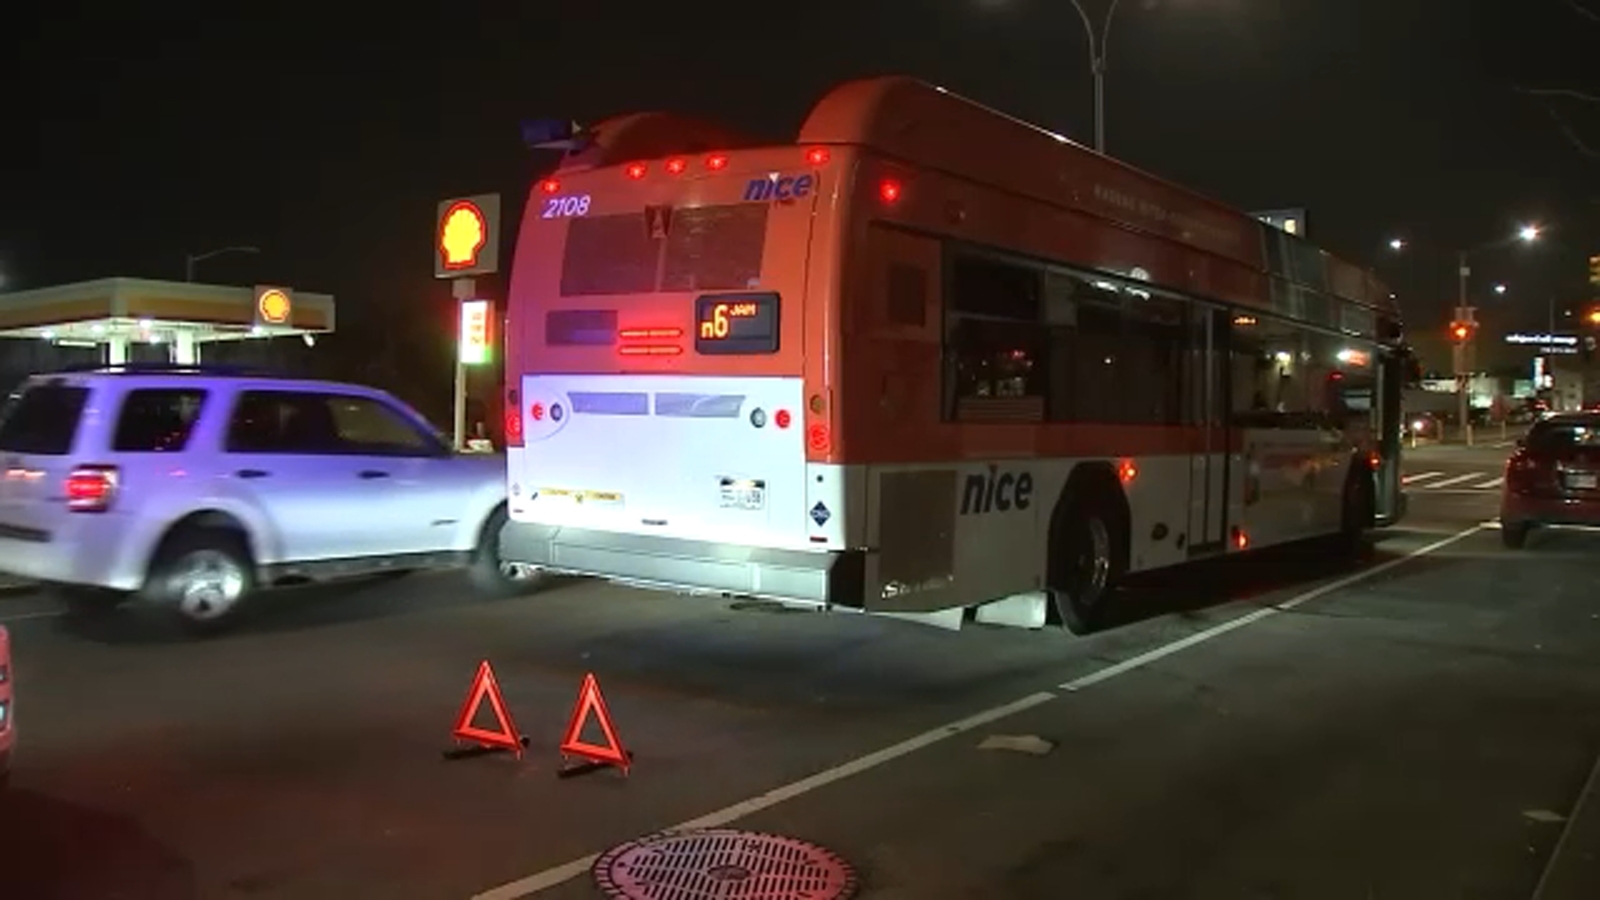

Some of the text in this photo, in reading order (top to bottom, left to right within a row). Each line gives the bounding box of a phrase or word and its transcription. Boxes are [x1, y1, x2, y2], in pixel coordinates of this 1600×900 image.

[743, 172, 812, 201] nice
[542, 195, 591, 218] 2108
[701, 304, 728, 338] n6
[960, 464, 1033, 515] nice
